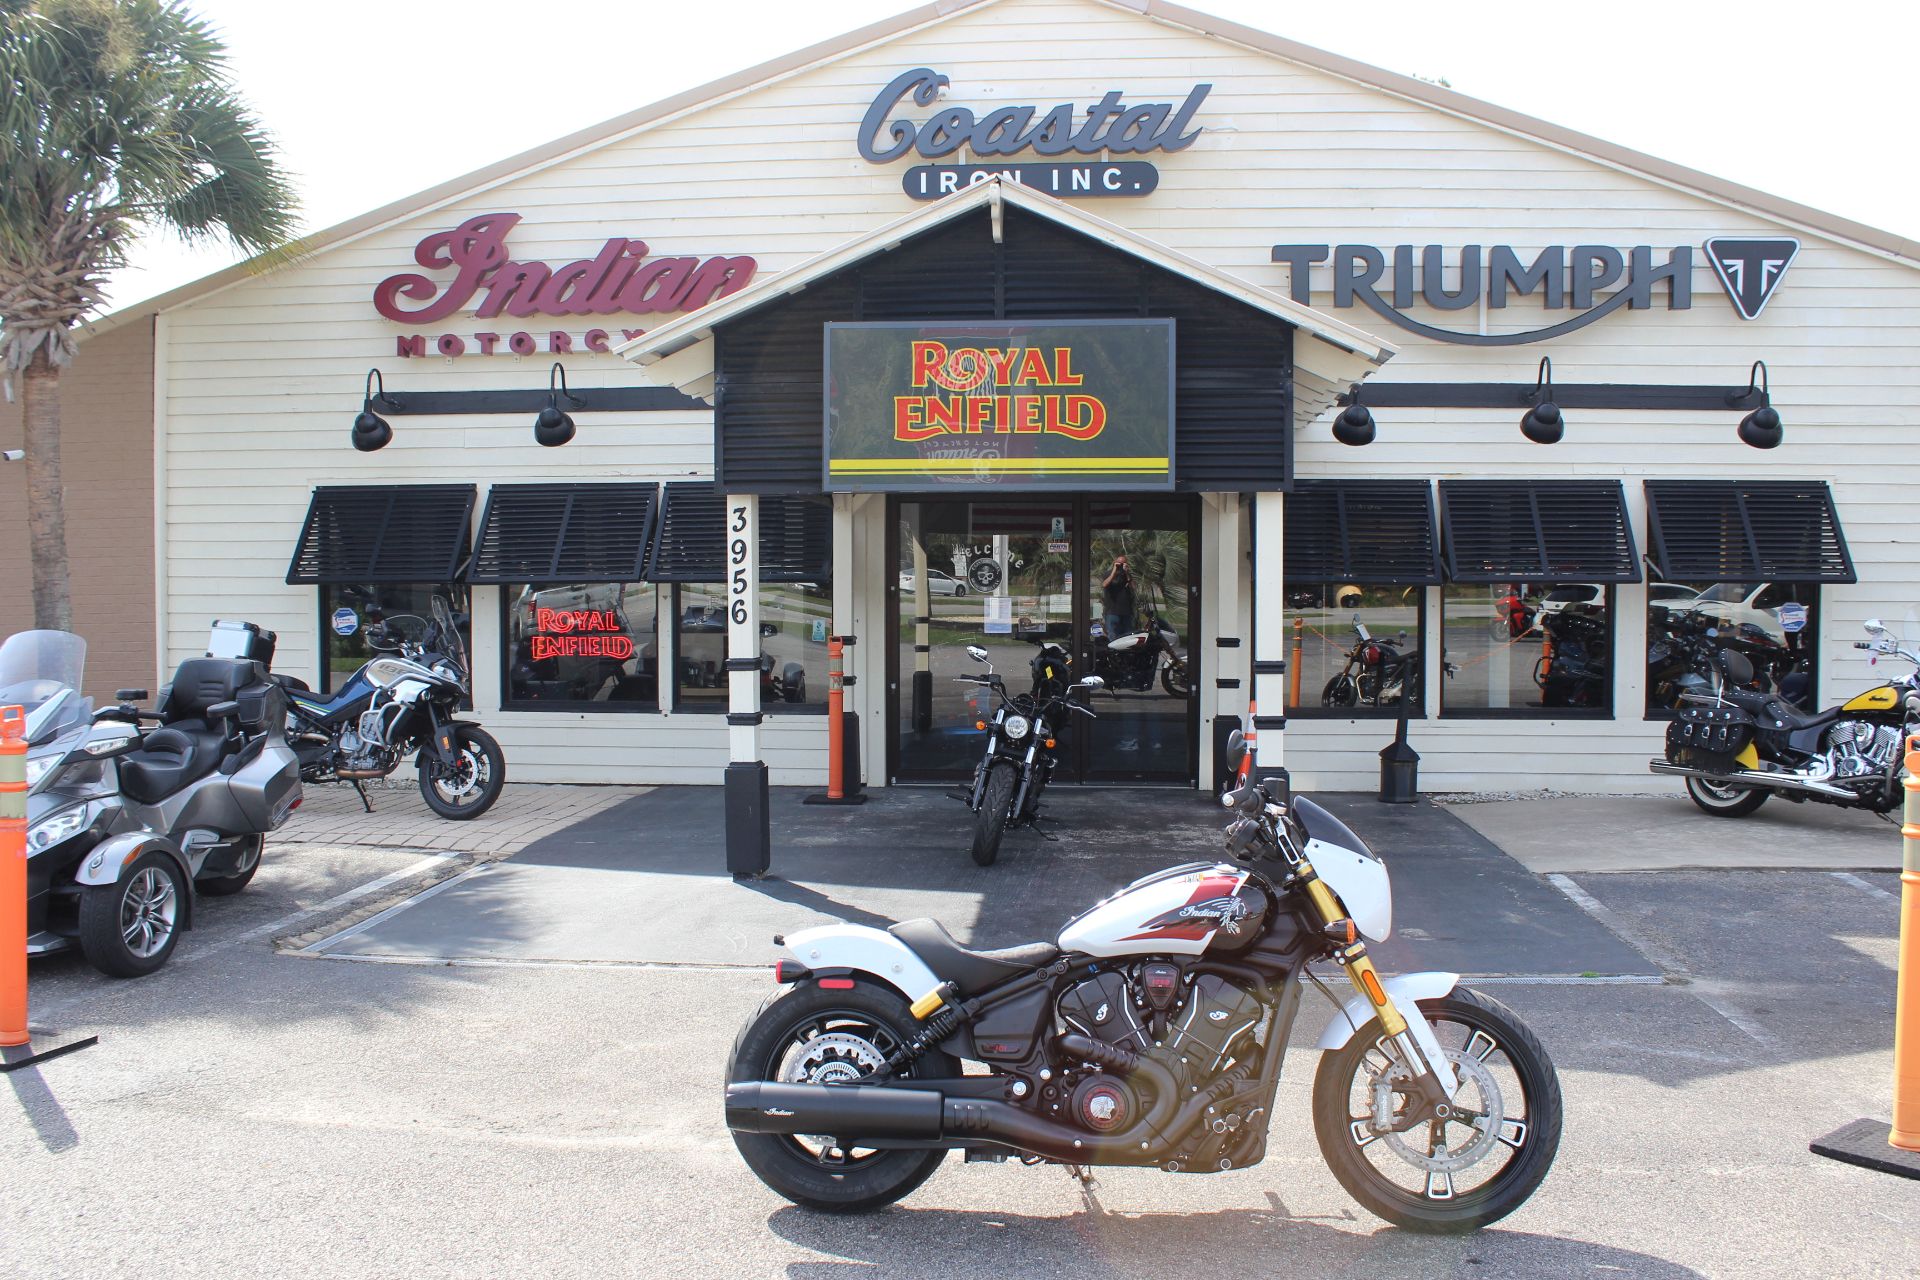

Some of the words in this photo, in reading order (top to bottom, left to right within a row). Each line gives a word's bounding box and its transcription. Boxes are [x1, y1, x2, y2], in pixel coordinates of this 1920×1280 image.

[857, 67, 1213, 164] Coastal
[1053, 168, 1141, 192] INC.
[373, 212, 759, 325] Indian
[1271, 244, 1692, 346] TRIUMPH
[911, 340, 1084, 391] ROYAL
[893, 394, 1107, 441] ENFIELD
[731, 506, 748, 625] 3956
[536, 607, 620, 634] ROYAL
[531, 636, 634, 660] ENFIELD
[1178, 905, 1222, 918] Indian
